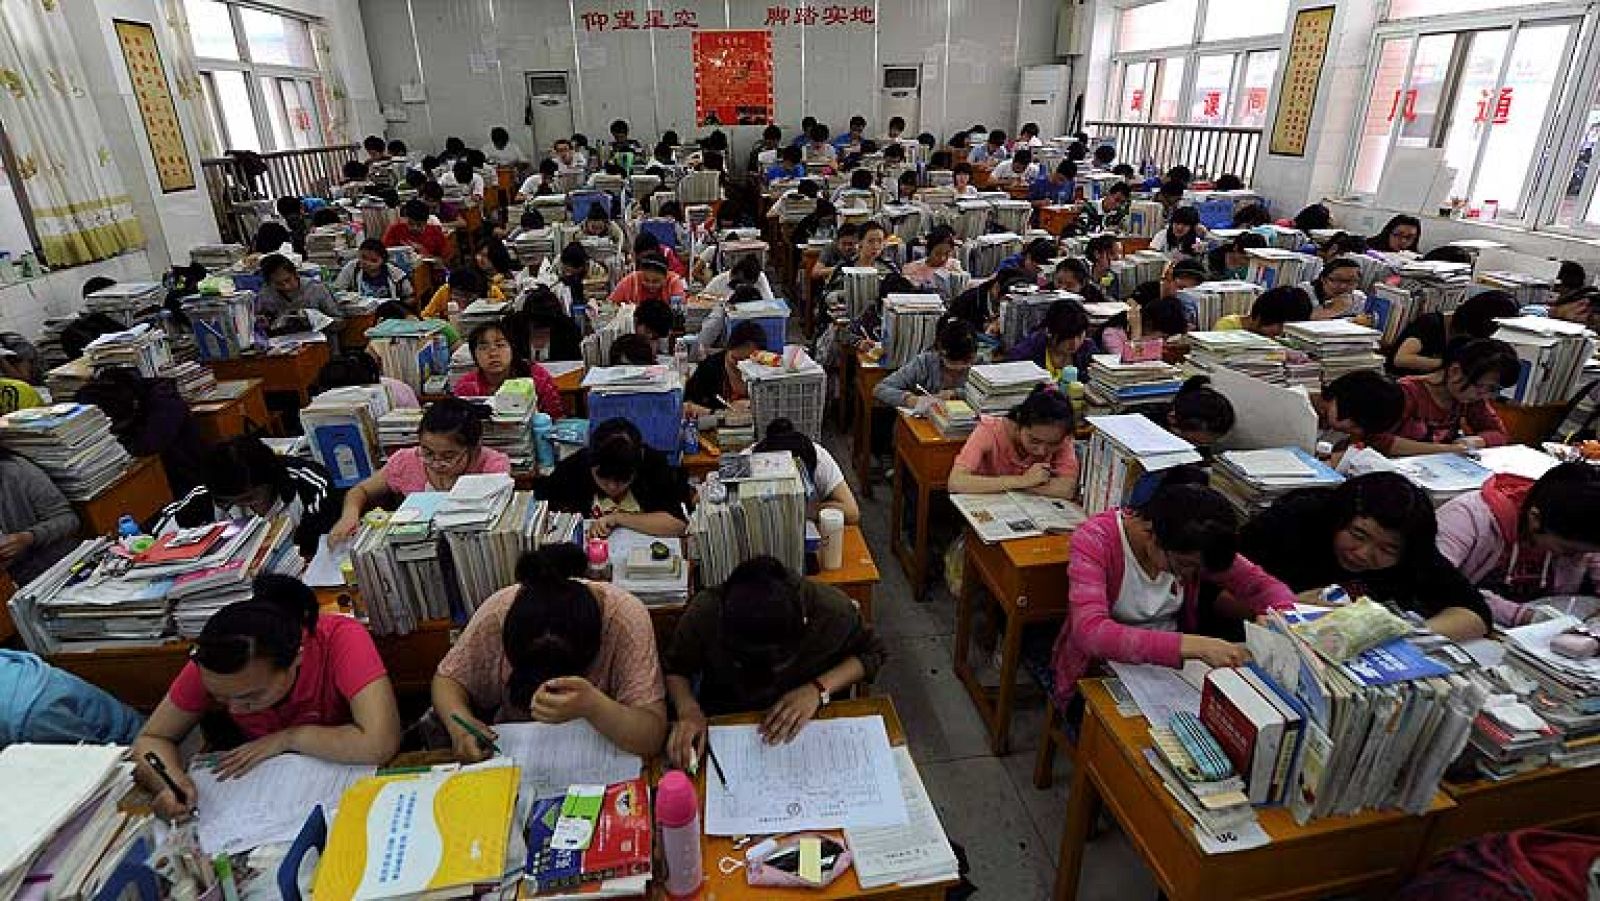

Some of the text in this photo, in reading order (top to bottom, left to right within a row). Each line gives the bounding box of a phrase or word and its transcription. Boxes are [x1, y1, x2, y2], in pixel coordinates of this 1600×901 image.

[581, 4, 876, 31] 仰望星空 脚踏实地
[1473, 87, 1513, 124] 通
